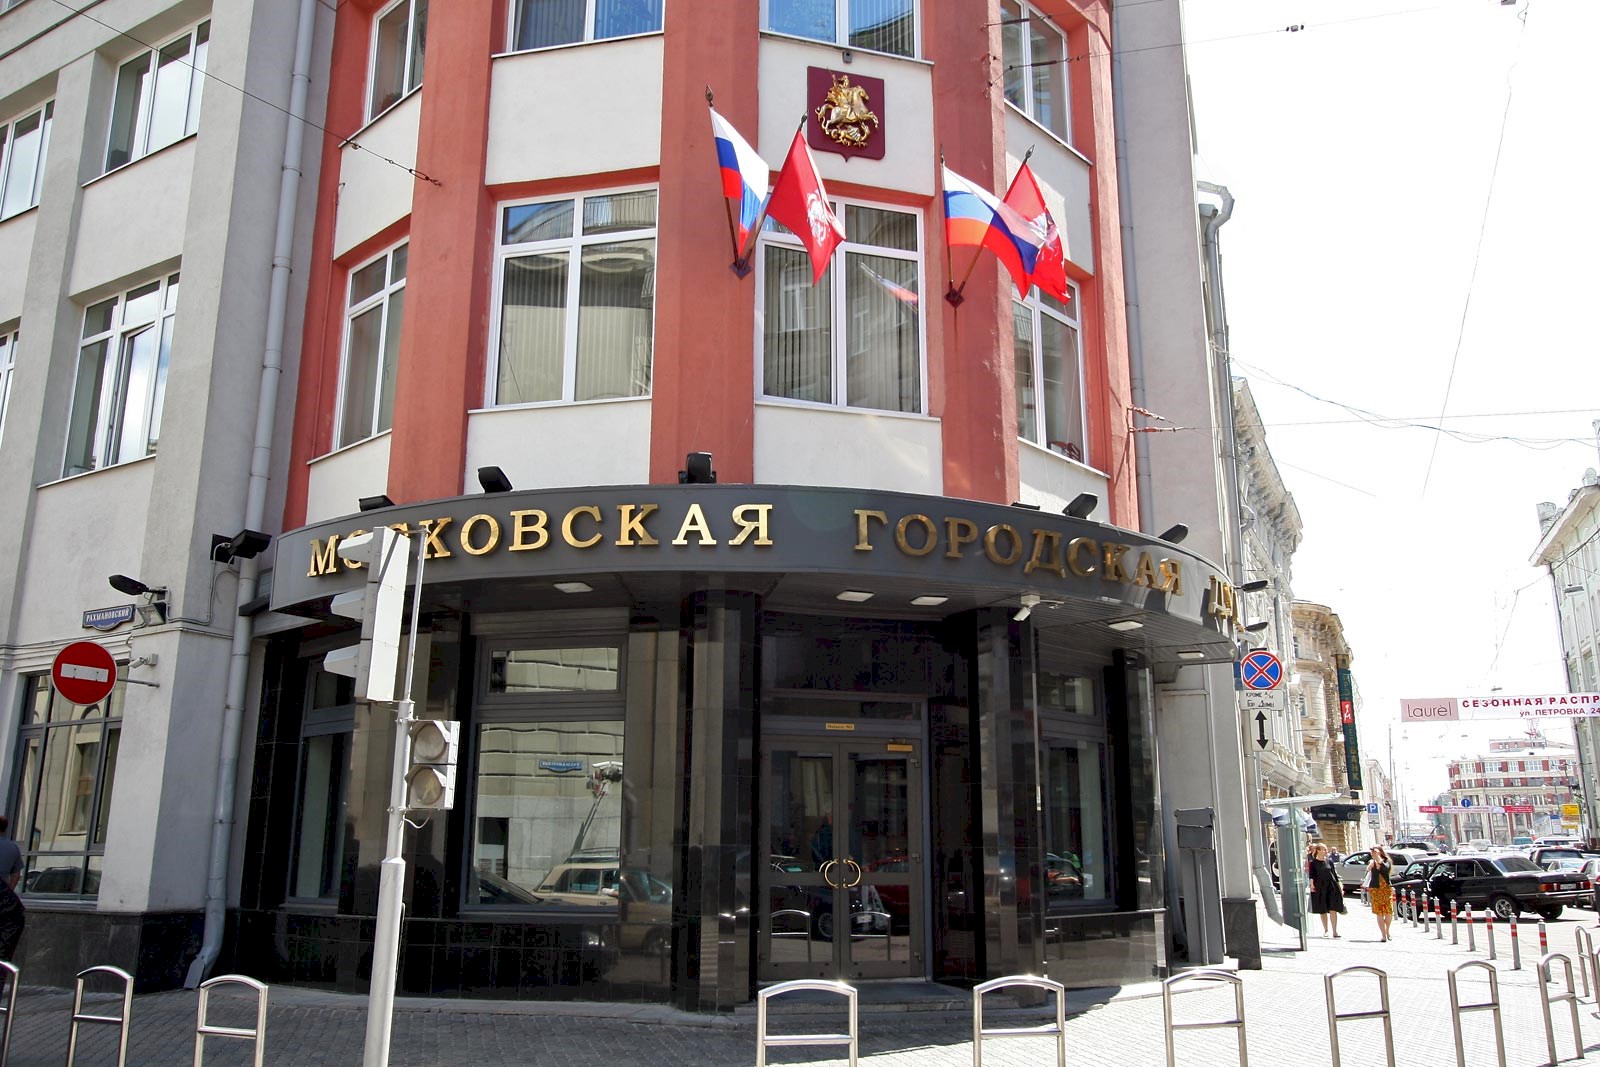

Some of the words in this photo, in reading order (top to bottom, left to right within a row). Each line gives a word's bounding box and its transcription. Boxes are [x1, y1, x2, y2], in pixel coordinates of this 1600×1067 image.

[853, 509, 1175, 597] ГОРОДСКАЯ
[86, 607, 130, 622] РАХМАНОВСКИЙ
[1462, 698, 1543, 708] СЕЗОННАЯ
[1549, 695, 1600, 705] РАСПР
